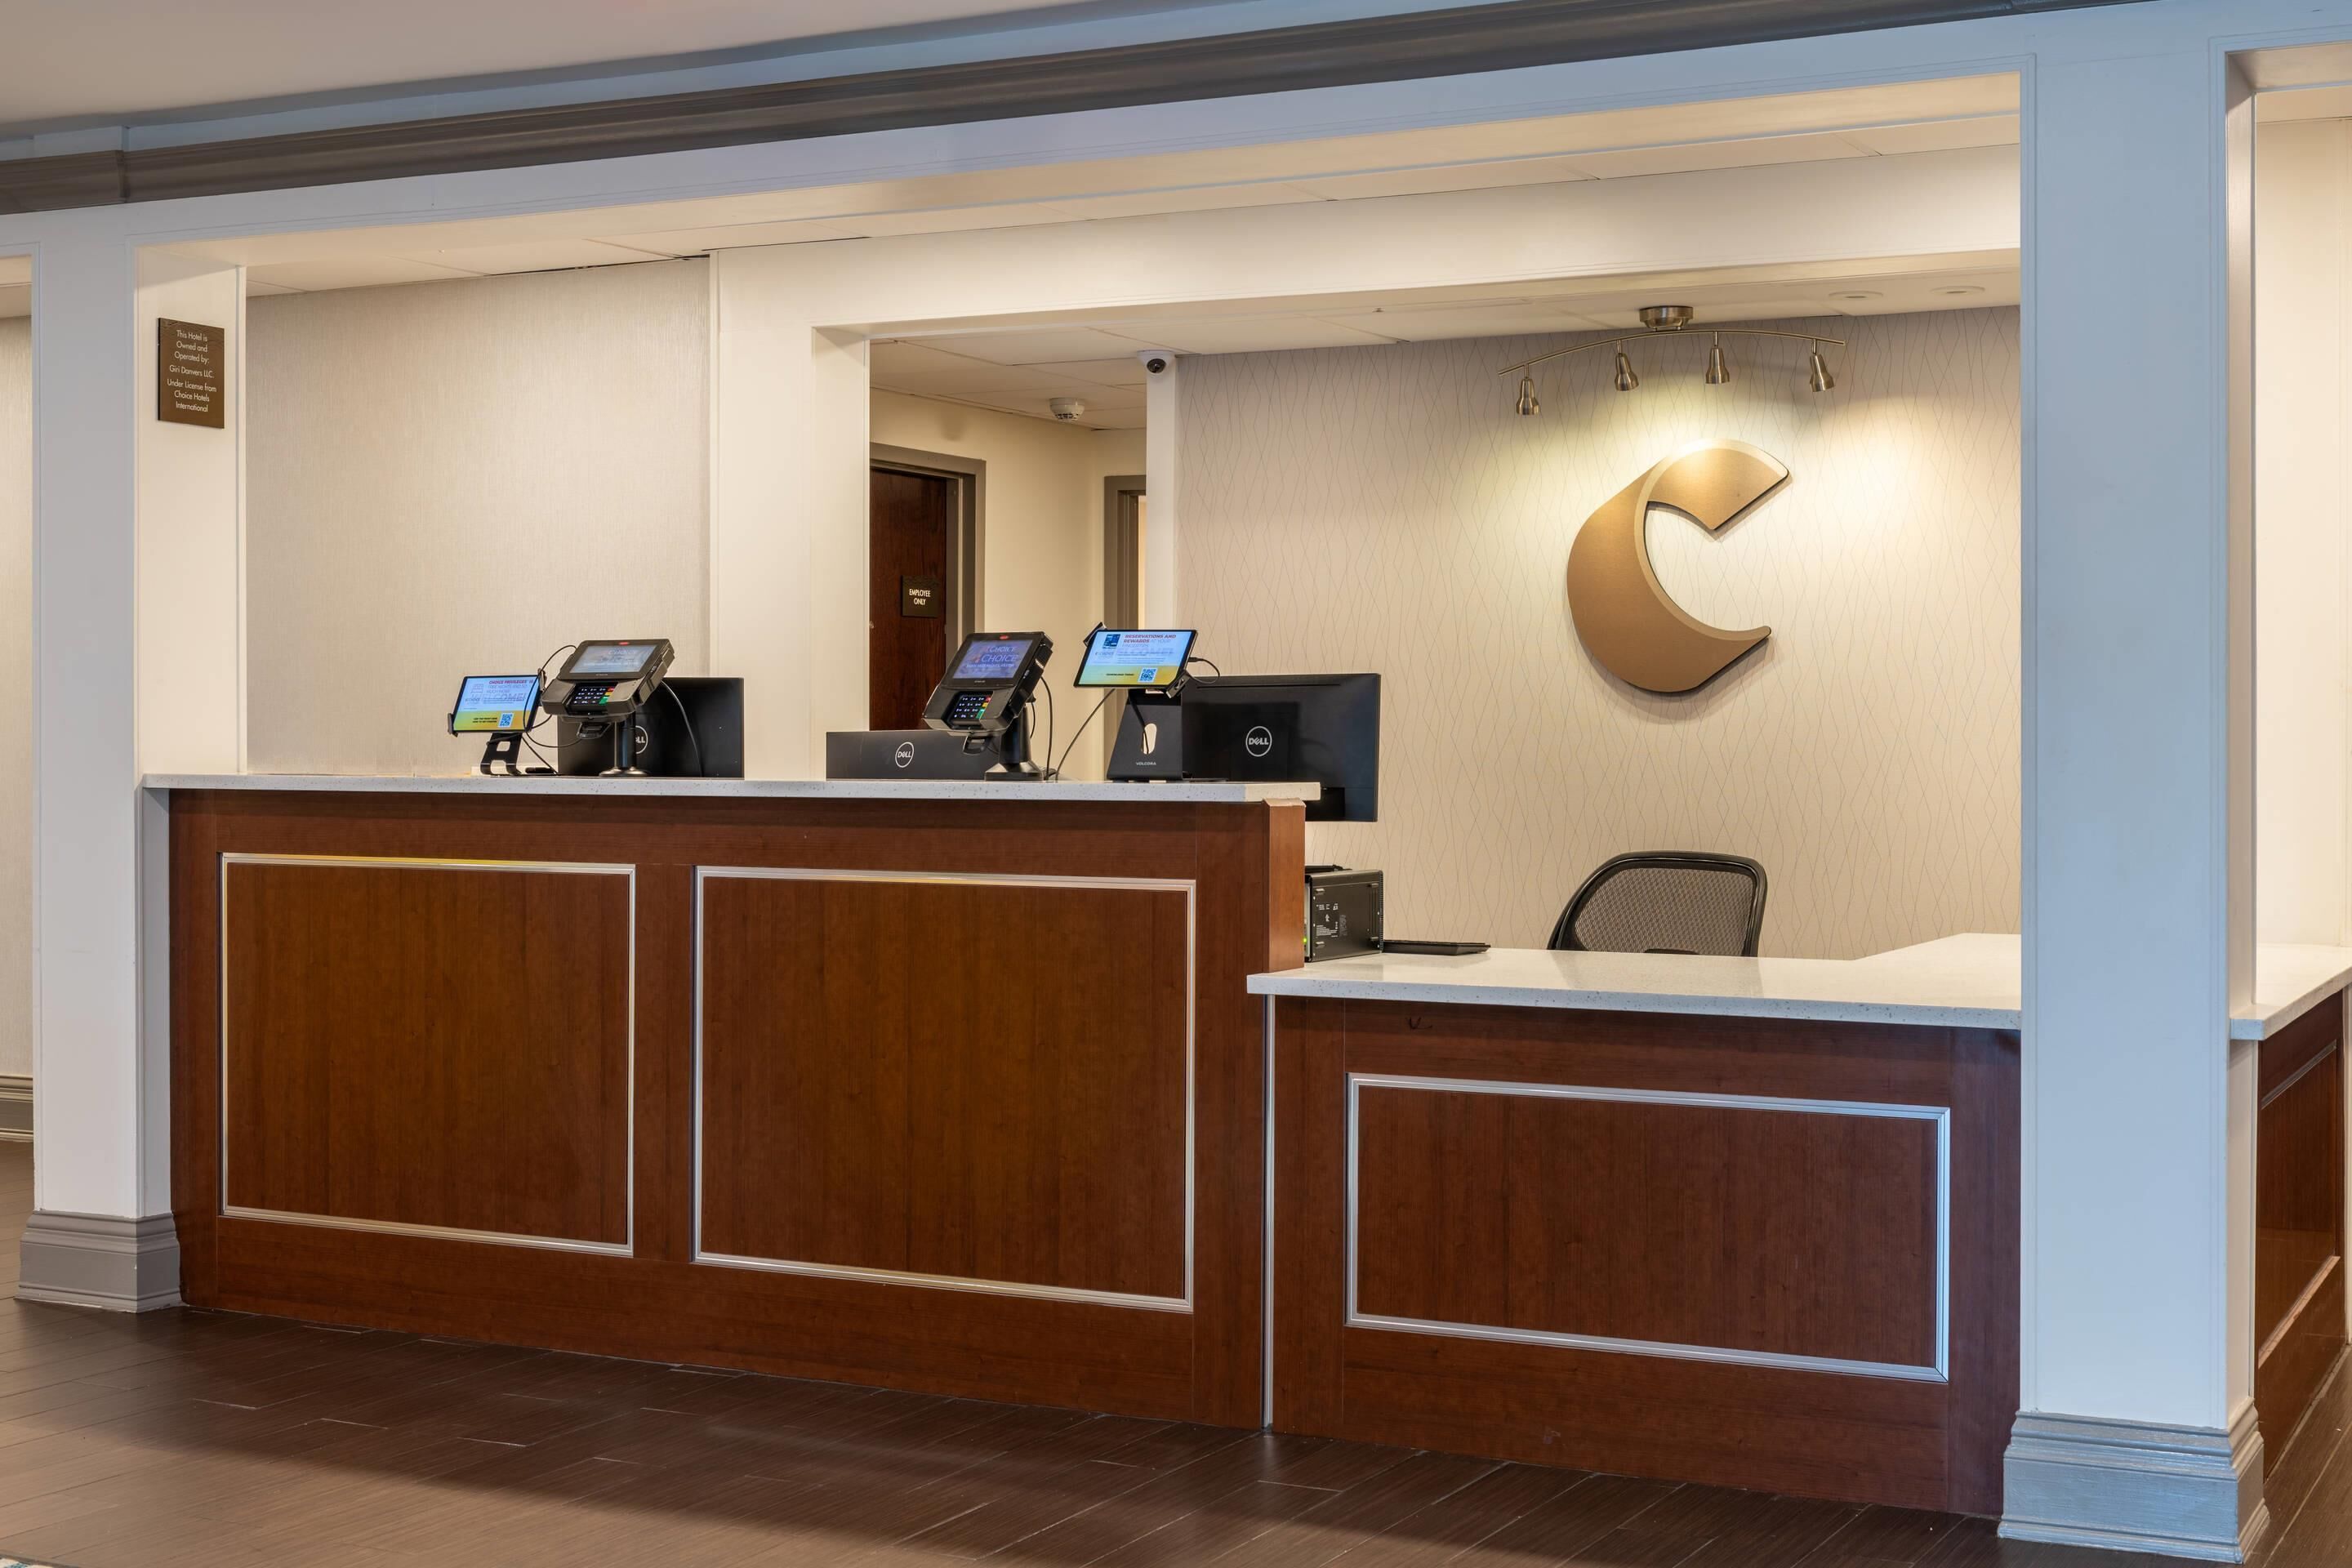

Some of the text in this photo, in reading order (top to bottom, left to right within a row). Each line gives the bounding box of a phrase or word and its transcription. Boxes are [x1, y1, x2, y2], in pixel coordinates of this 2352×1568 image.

[176, 330, 187, 338] This
[189, 332, 202, 341] Hotel
[176, 341, 196, 350] Owned
[174, 351, 209, 365] Operated by:
[169, 364, 180, 372] Giri
[181, 367, 203, 376] Danvers
[167, 378, 216, 392] Under License from
[174, 390, 209, 402] Choice Hotels
[176, 401, 208, 412] International
[909, 588, 931, 597] EMPLOYEE
[913, 597, 926, 605] ONLY
[981, 654, 1019, 662] CHOICE
